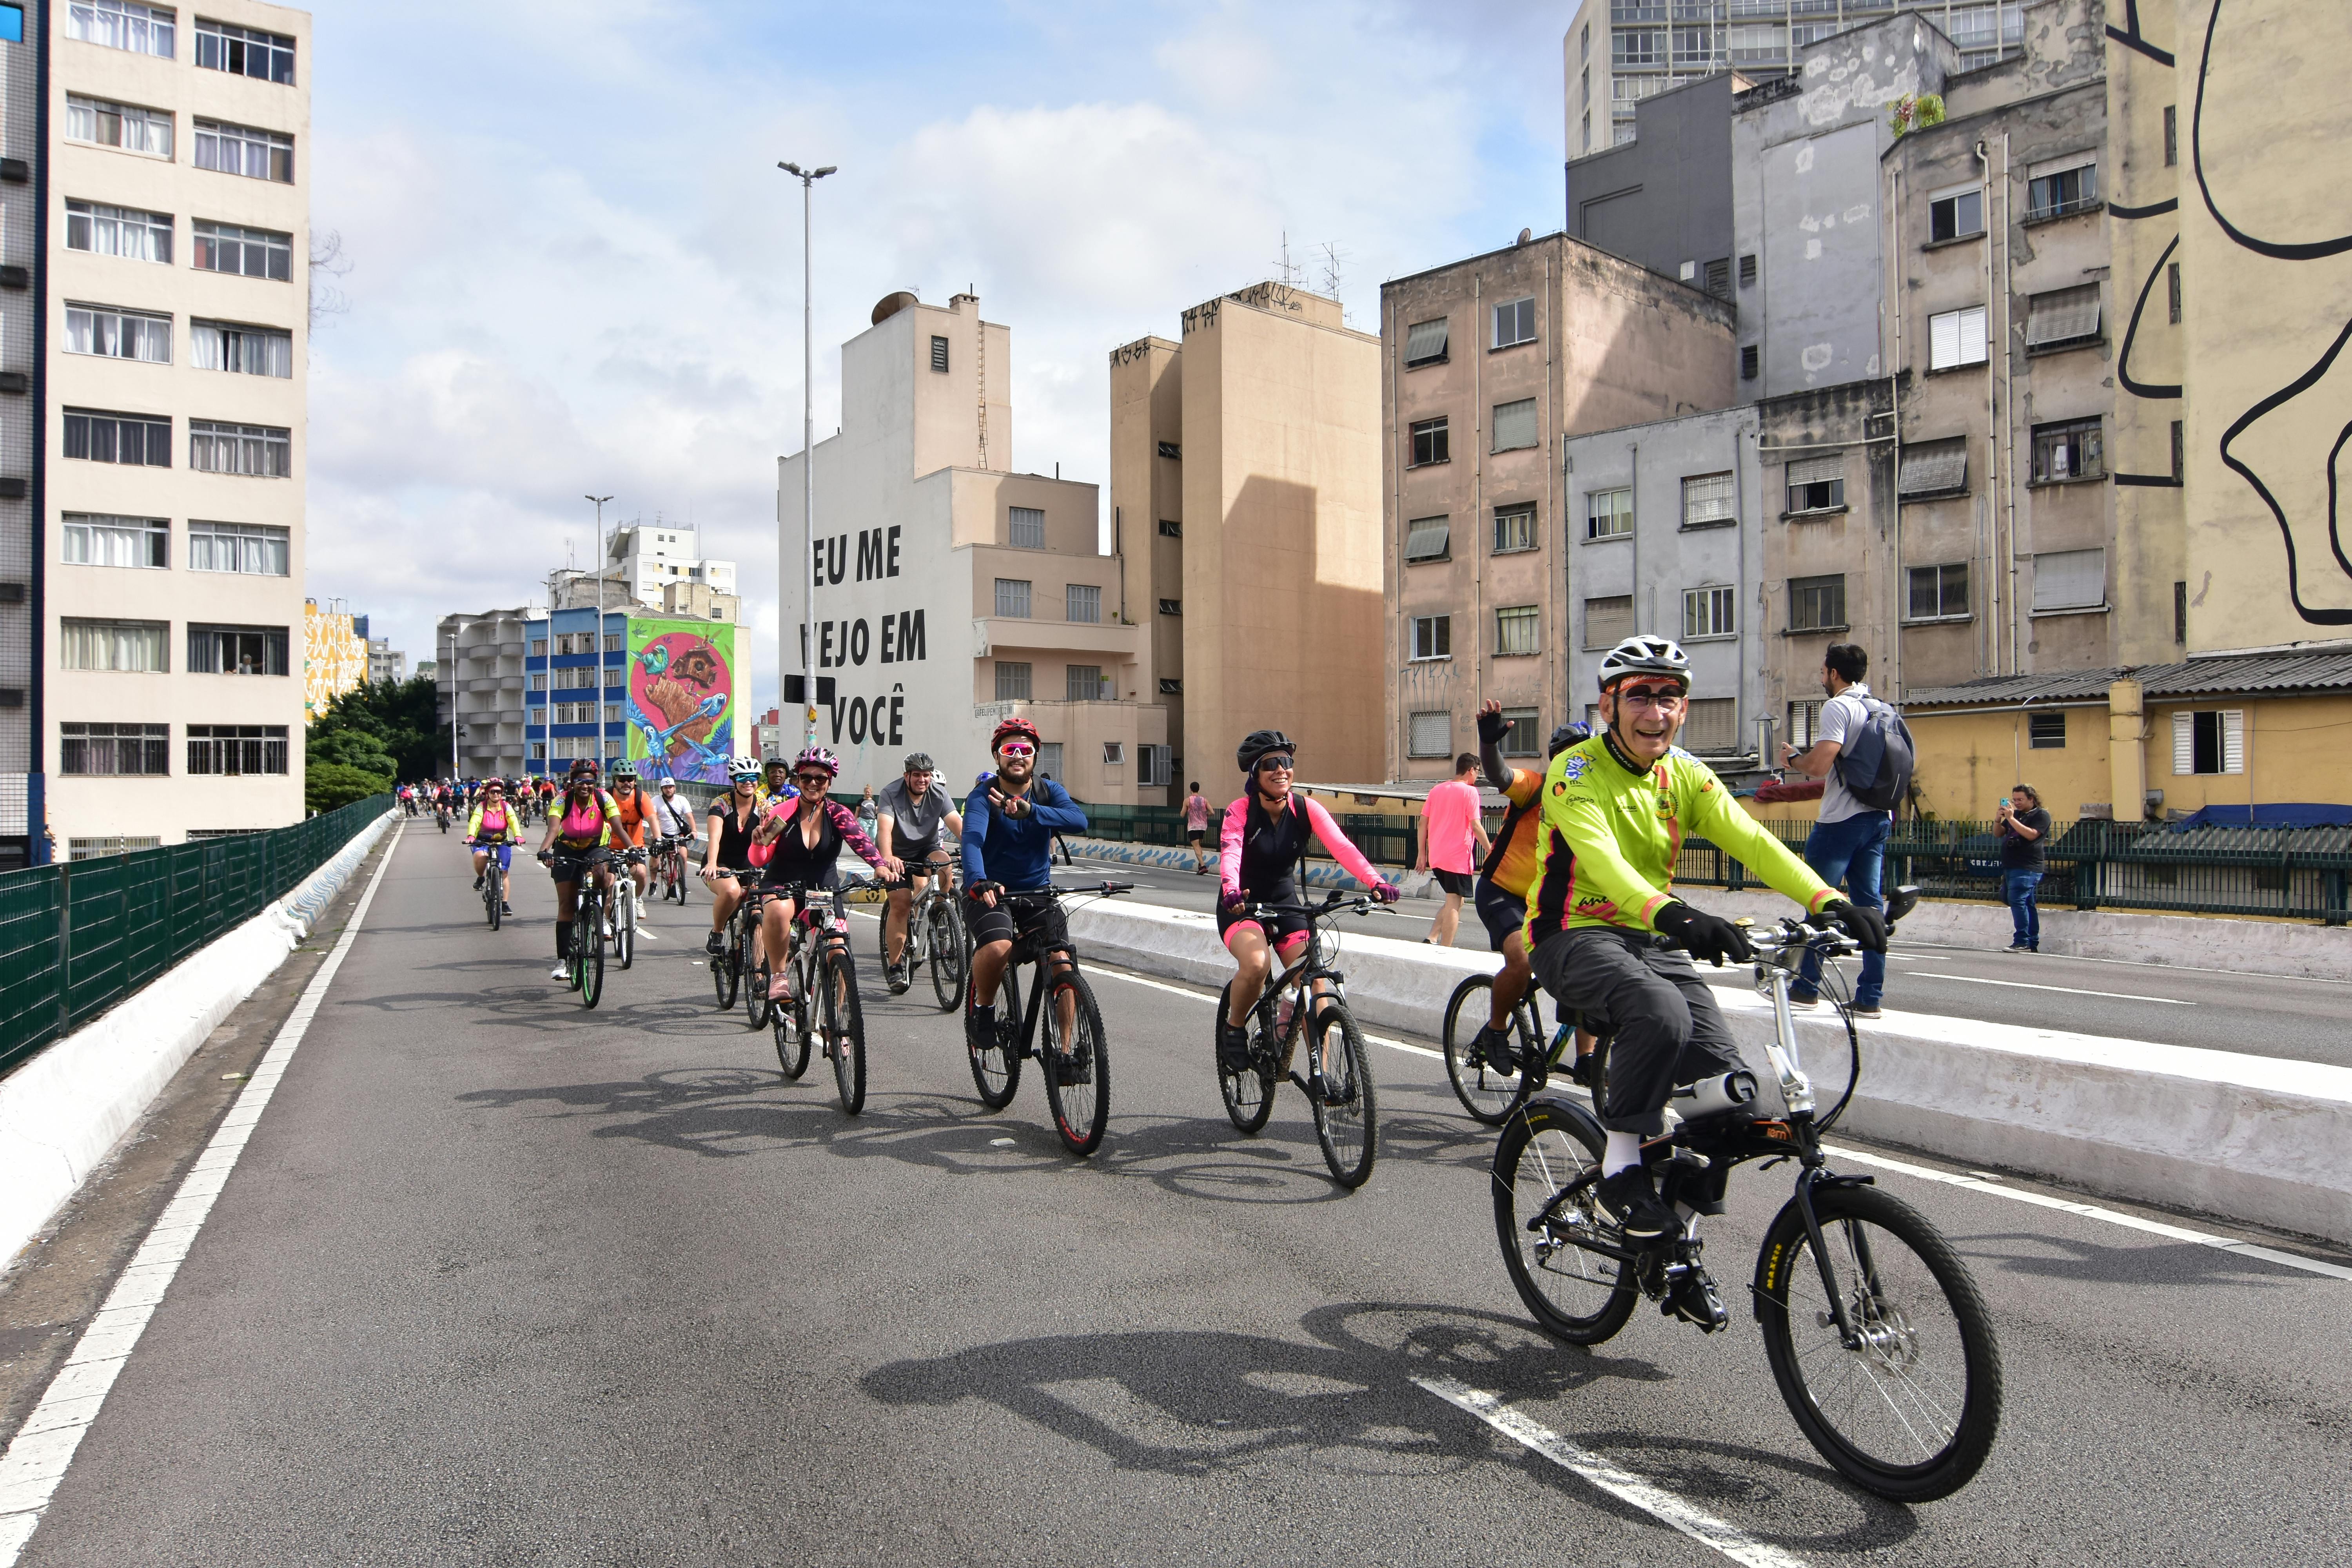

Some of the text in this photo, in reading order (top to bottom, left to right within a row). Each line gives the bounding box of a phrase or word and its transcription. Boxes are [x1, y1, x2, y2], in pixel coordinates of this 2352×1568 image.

[813, 525, 901, 586] EU ME
[880, 609, 926, 664] EM
[831, 682, 904, 746] VOCÊ
[1766, 1243, 1782, 1290] MAXXIS
